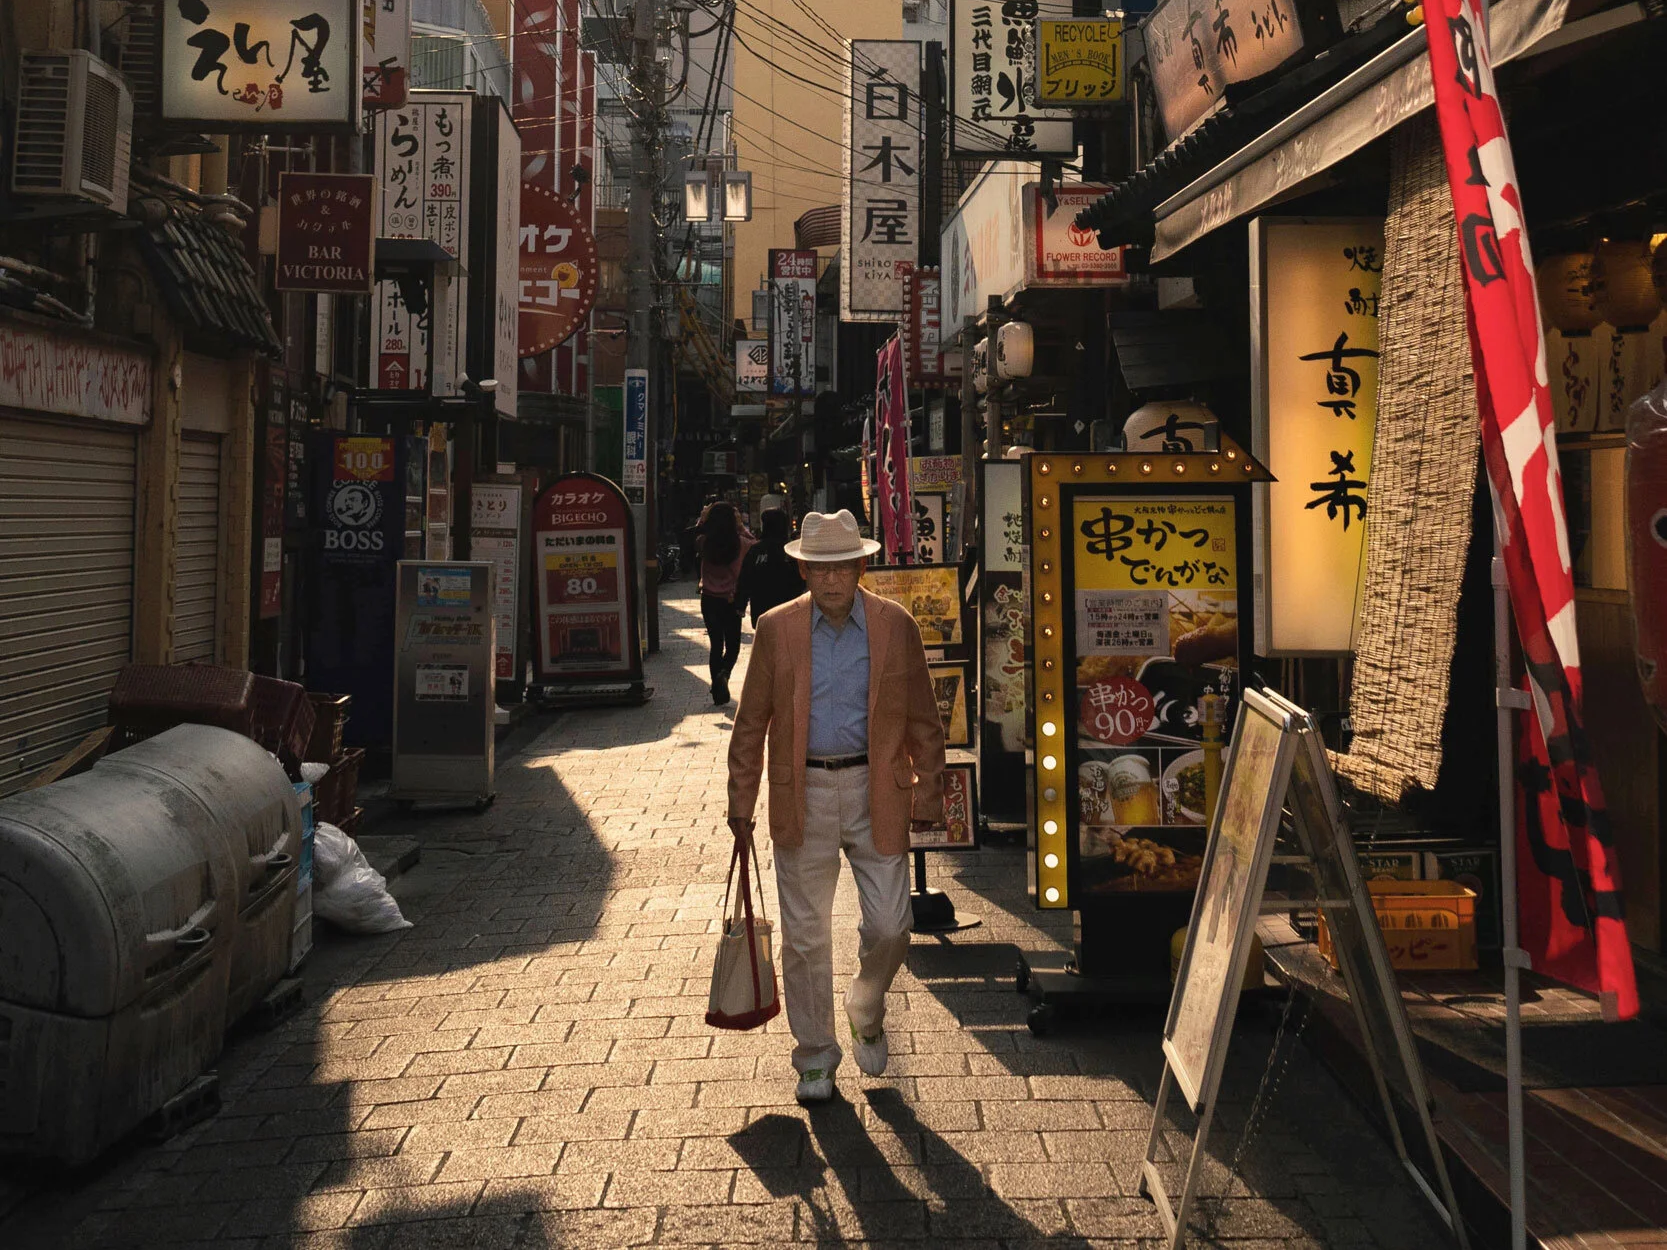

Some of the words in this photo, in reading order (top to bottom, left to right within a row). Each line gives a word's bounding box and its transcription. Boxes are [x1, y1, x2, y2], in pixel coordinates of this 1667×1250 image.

[1054, 25, 1107, 43] RECYCLE
[971, 6, 993, 122] 三代目網元
[1087, 49, 1111, 64] BOOK
[1046, 79, 1117, 98] ブリッジ
[431, 107, 455, 180] もつ煮
[391, 114, 419, 209] らーめん
[859, 67, 917, 245] 白木屋
[290, 189, 362, 209] 世界の銘酒
[320, 205, 331, 215] &
[308, 245, 342, 260] BAR
[1046, 252, 1081, 262] FLOWER
[1083, 252, 1117, 262] RECORD
[283, 264, 365, 280] VICTORIA
[1298, 331, 1381, 533] 真希
[343, 452, 384, 470] 100
[551, 491, 605, 506] カラオケ
[324, 529, 384, 550] BOSS
[1080, 506, 1210, 562] 串かつ
[1119, 555, 1230, 587] でんがな
[567, 577, 598, 595] 80
[1089, 682, 1149, 714] 串かつ
